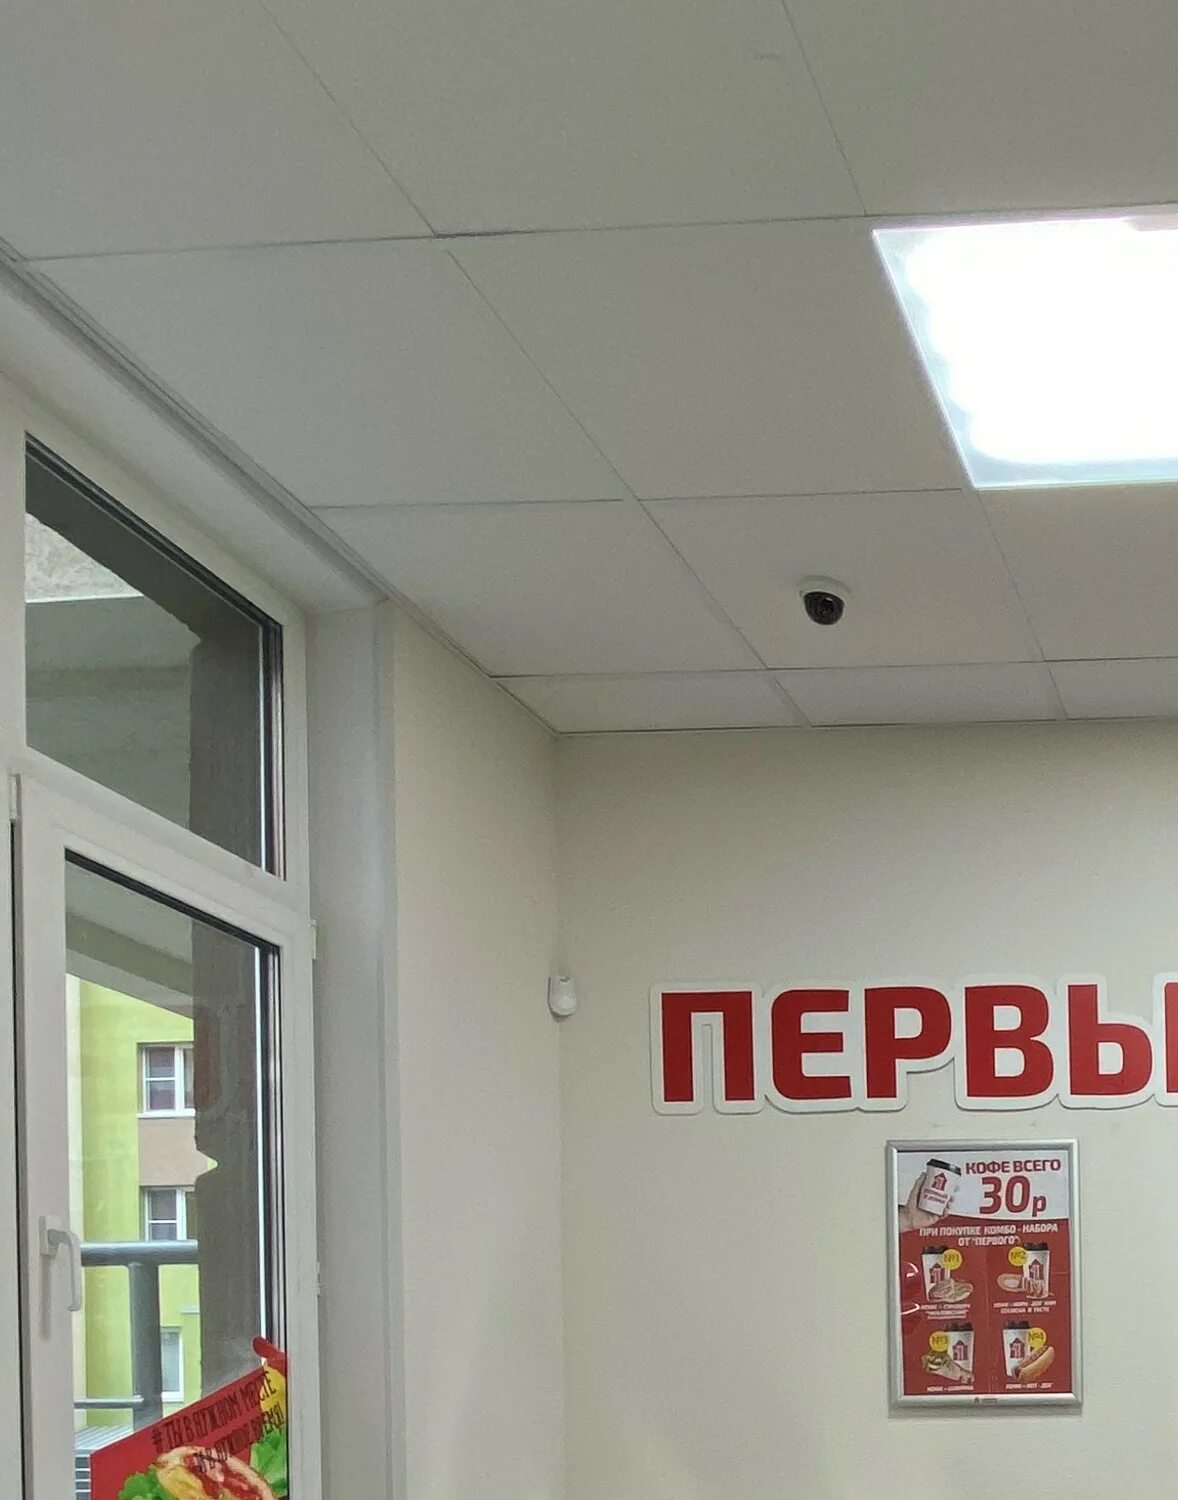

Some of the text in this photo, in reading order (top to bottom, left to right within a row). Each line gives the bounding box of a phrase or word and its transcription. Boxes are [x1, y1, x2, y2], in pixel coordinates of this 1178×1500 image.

[965, 1158, 1062, 1175] КОФЕ ВСЕГО
[919, 1228, 939, 1237] ПРИ
[940, 1226, 981, 1236] ПОКУПКЕ
[984, 1225, 1016, 1235] КОМБО
[1022, 1223, 1059, 1233] НАБОРА
[958, 1236, 969, 1246] ОТ
